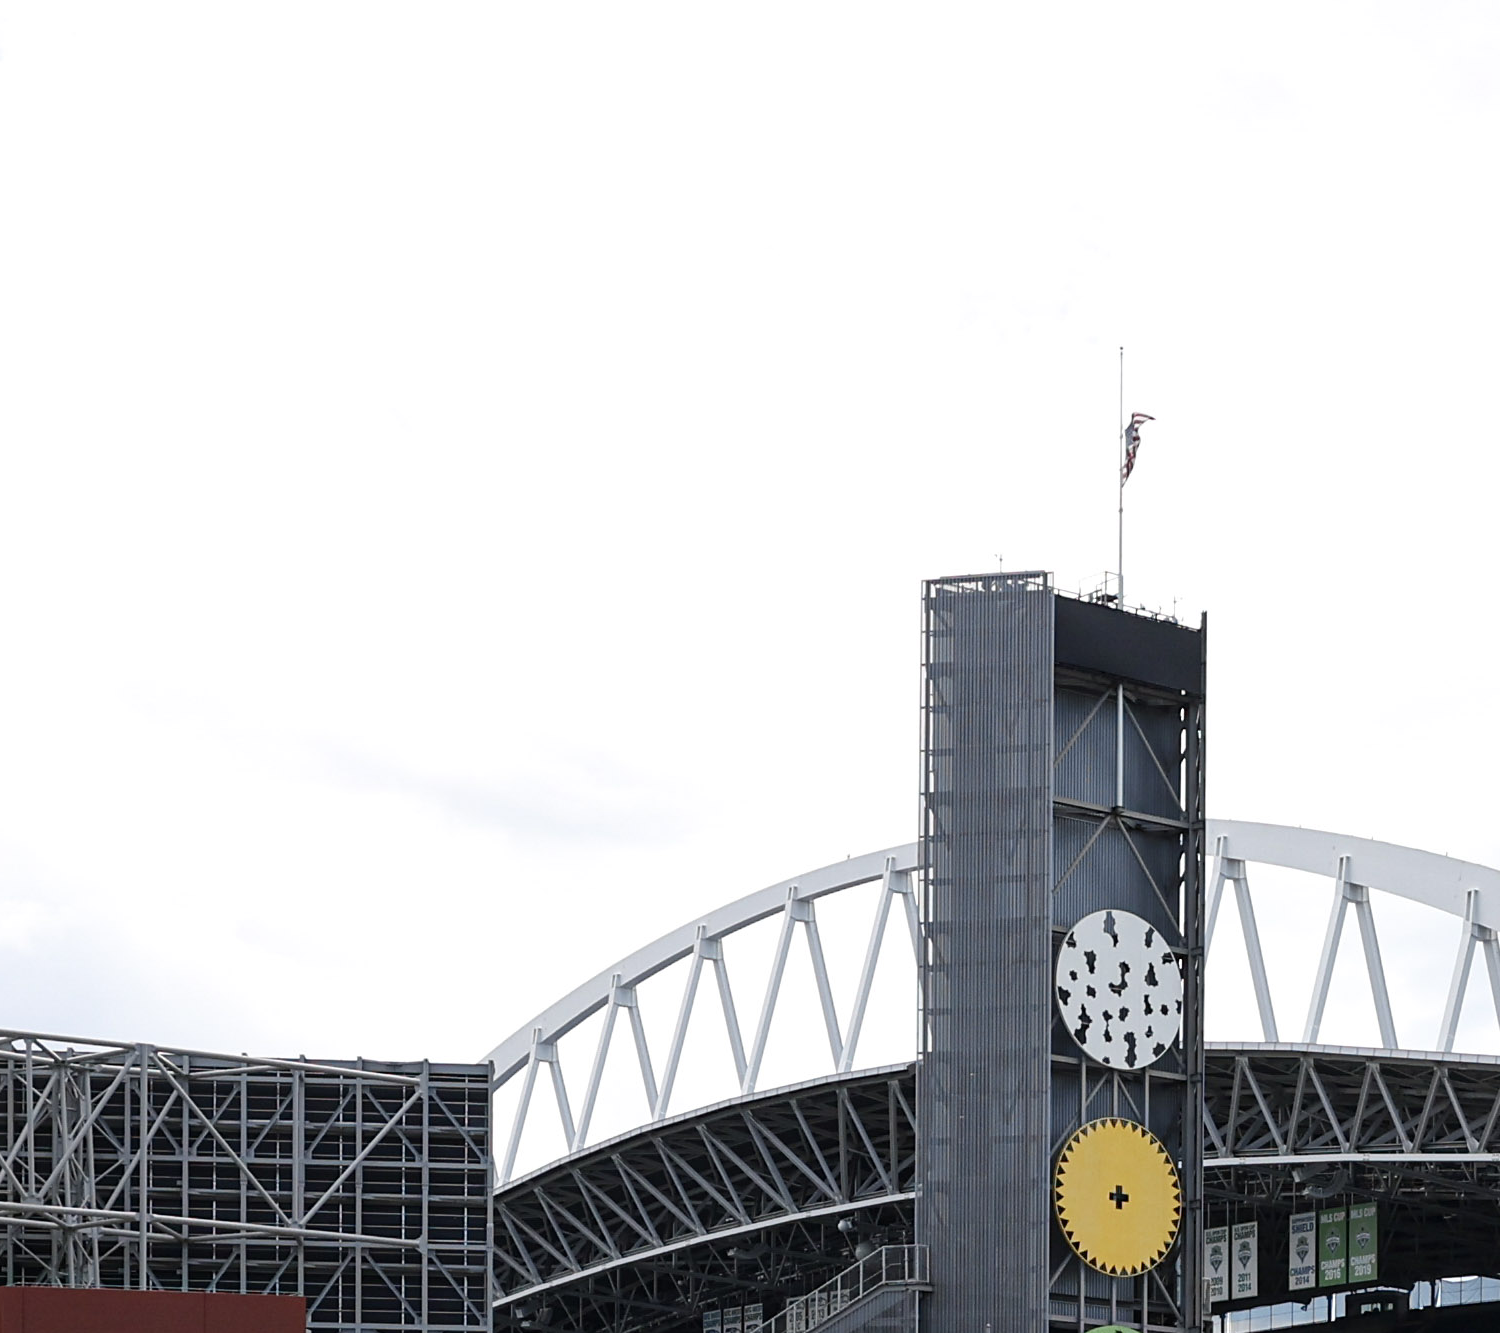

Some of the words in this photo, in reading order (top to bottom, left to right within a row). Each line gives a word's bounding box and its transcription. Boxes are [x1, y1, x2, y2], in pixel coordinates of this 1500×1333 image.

[1292, 1223, 1314, 1233] SHIELD
[1321, 1259, 1345, 1270] CHAMPS
[1351, 1254, 1375, 1266] CHAMPS
[1290, 1265, 1315, 1276] CHAMPS
[1295, 1275, 1310, 1286] 2014
